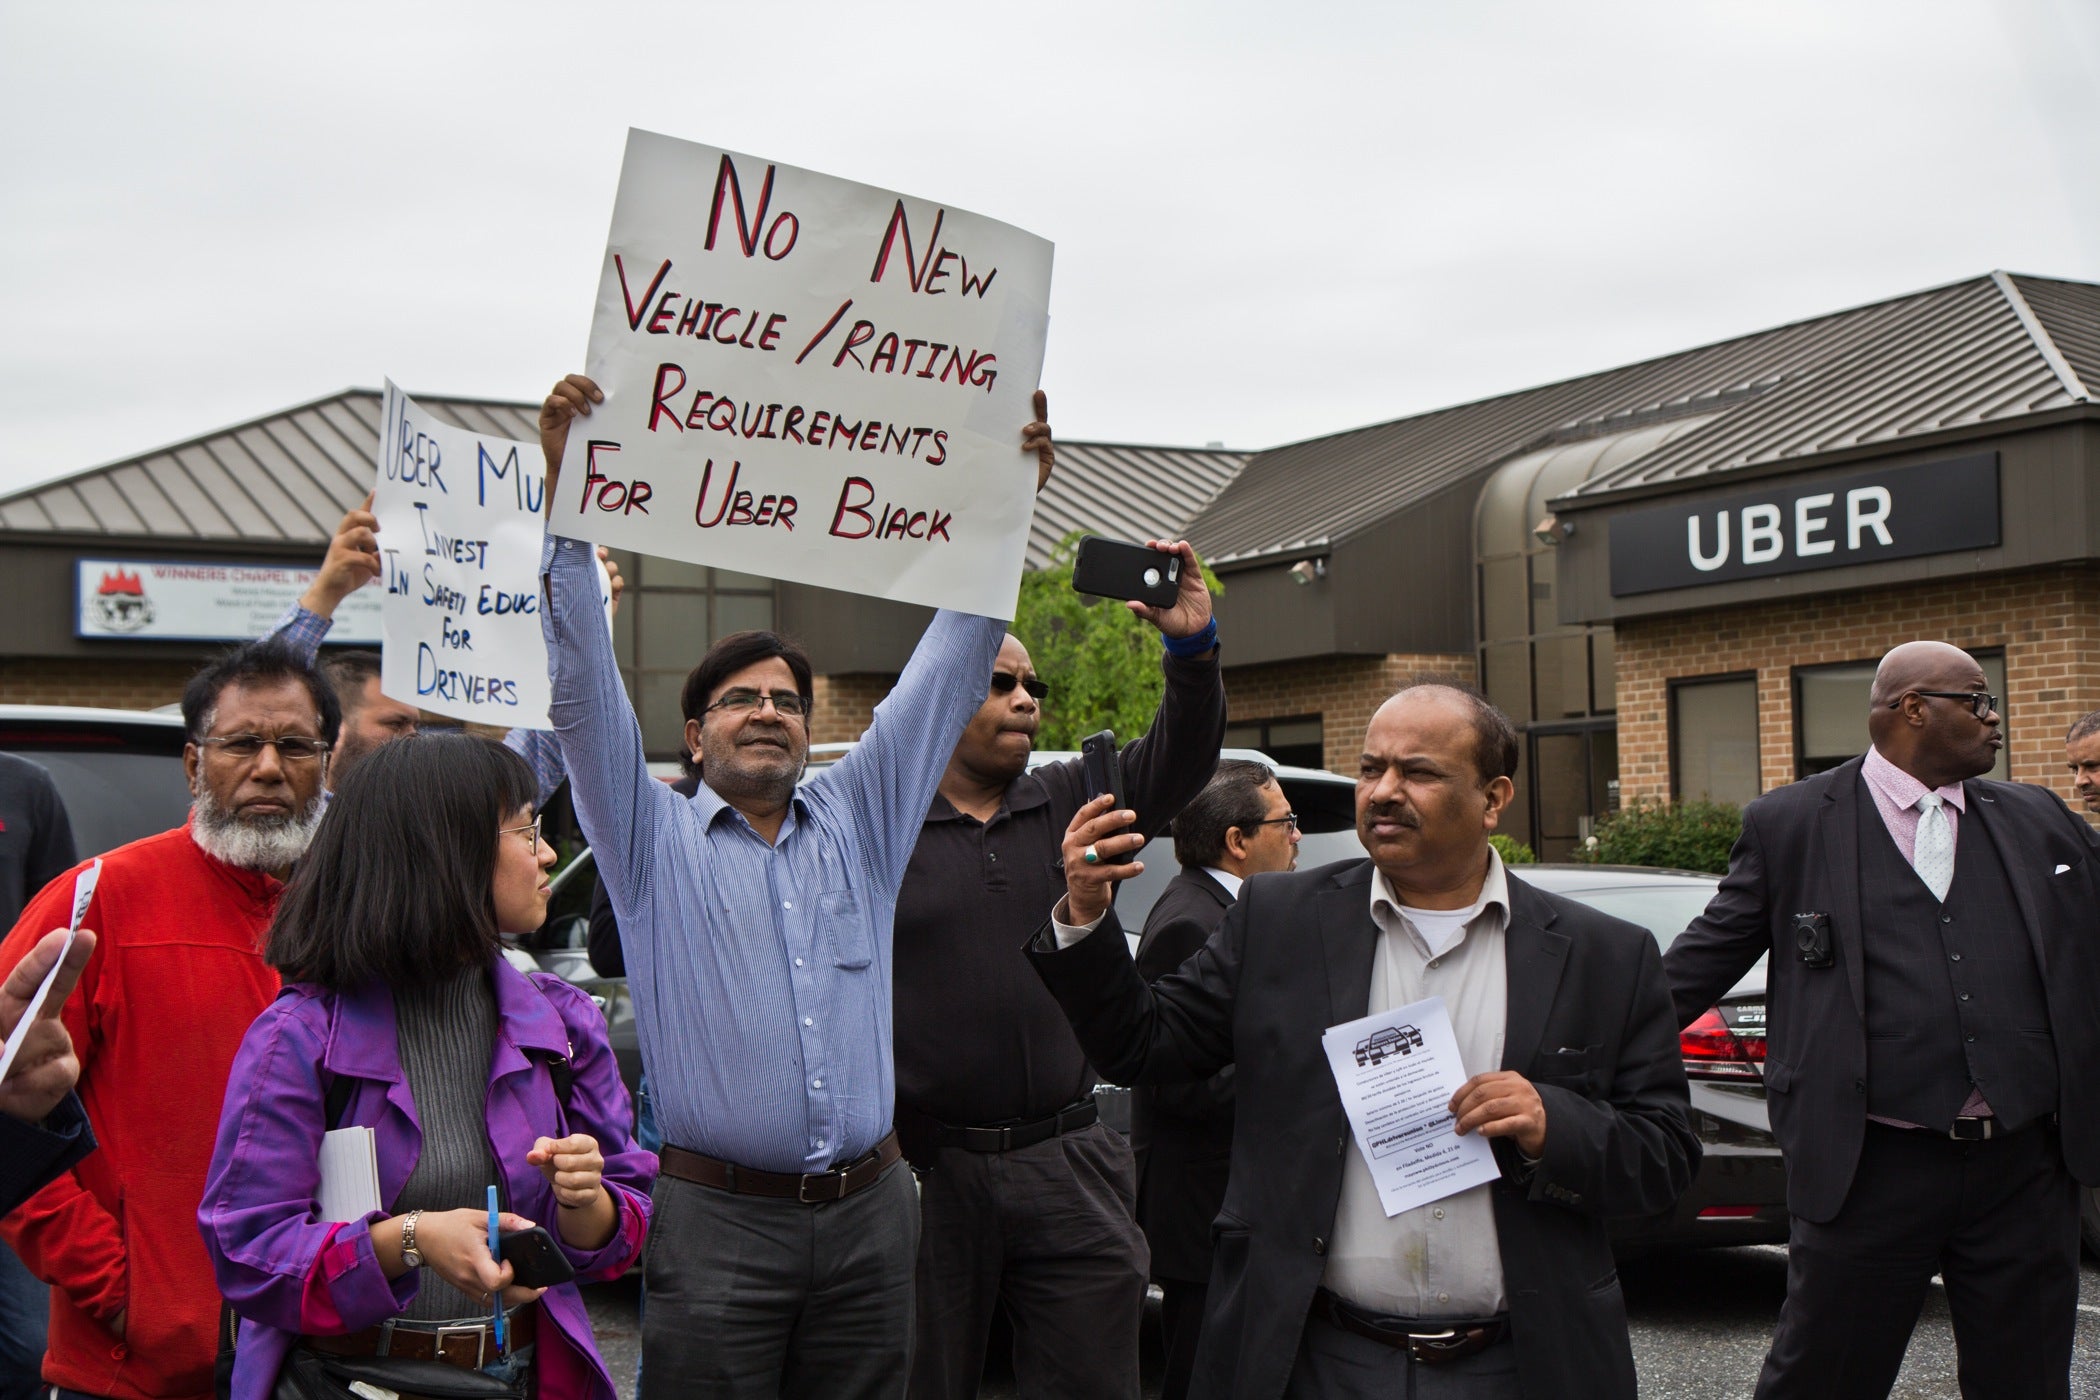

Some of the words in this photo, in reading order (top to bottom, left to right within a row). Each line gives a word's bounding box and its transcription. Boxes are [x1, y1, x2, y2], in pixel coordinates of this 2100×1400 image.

[1687, 485, 1894, 571] UBER
[477, 584, 541, 616] EDUC
[417, 641, 518, 706] DRIVERS
